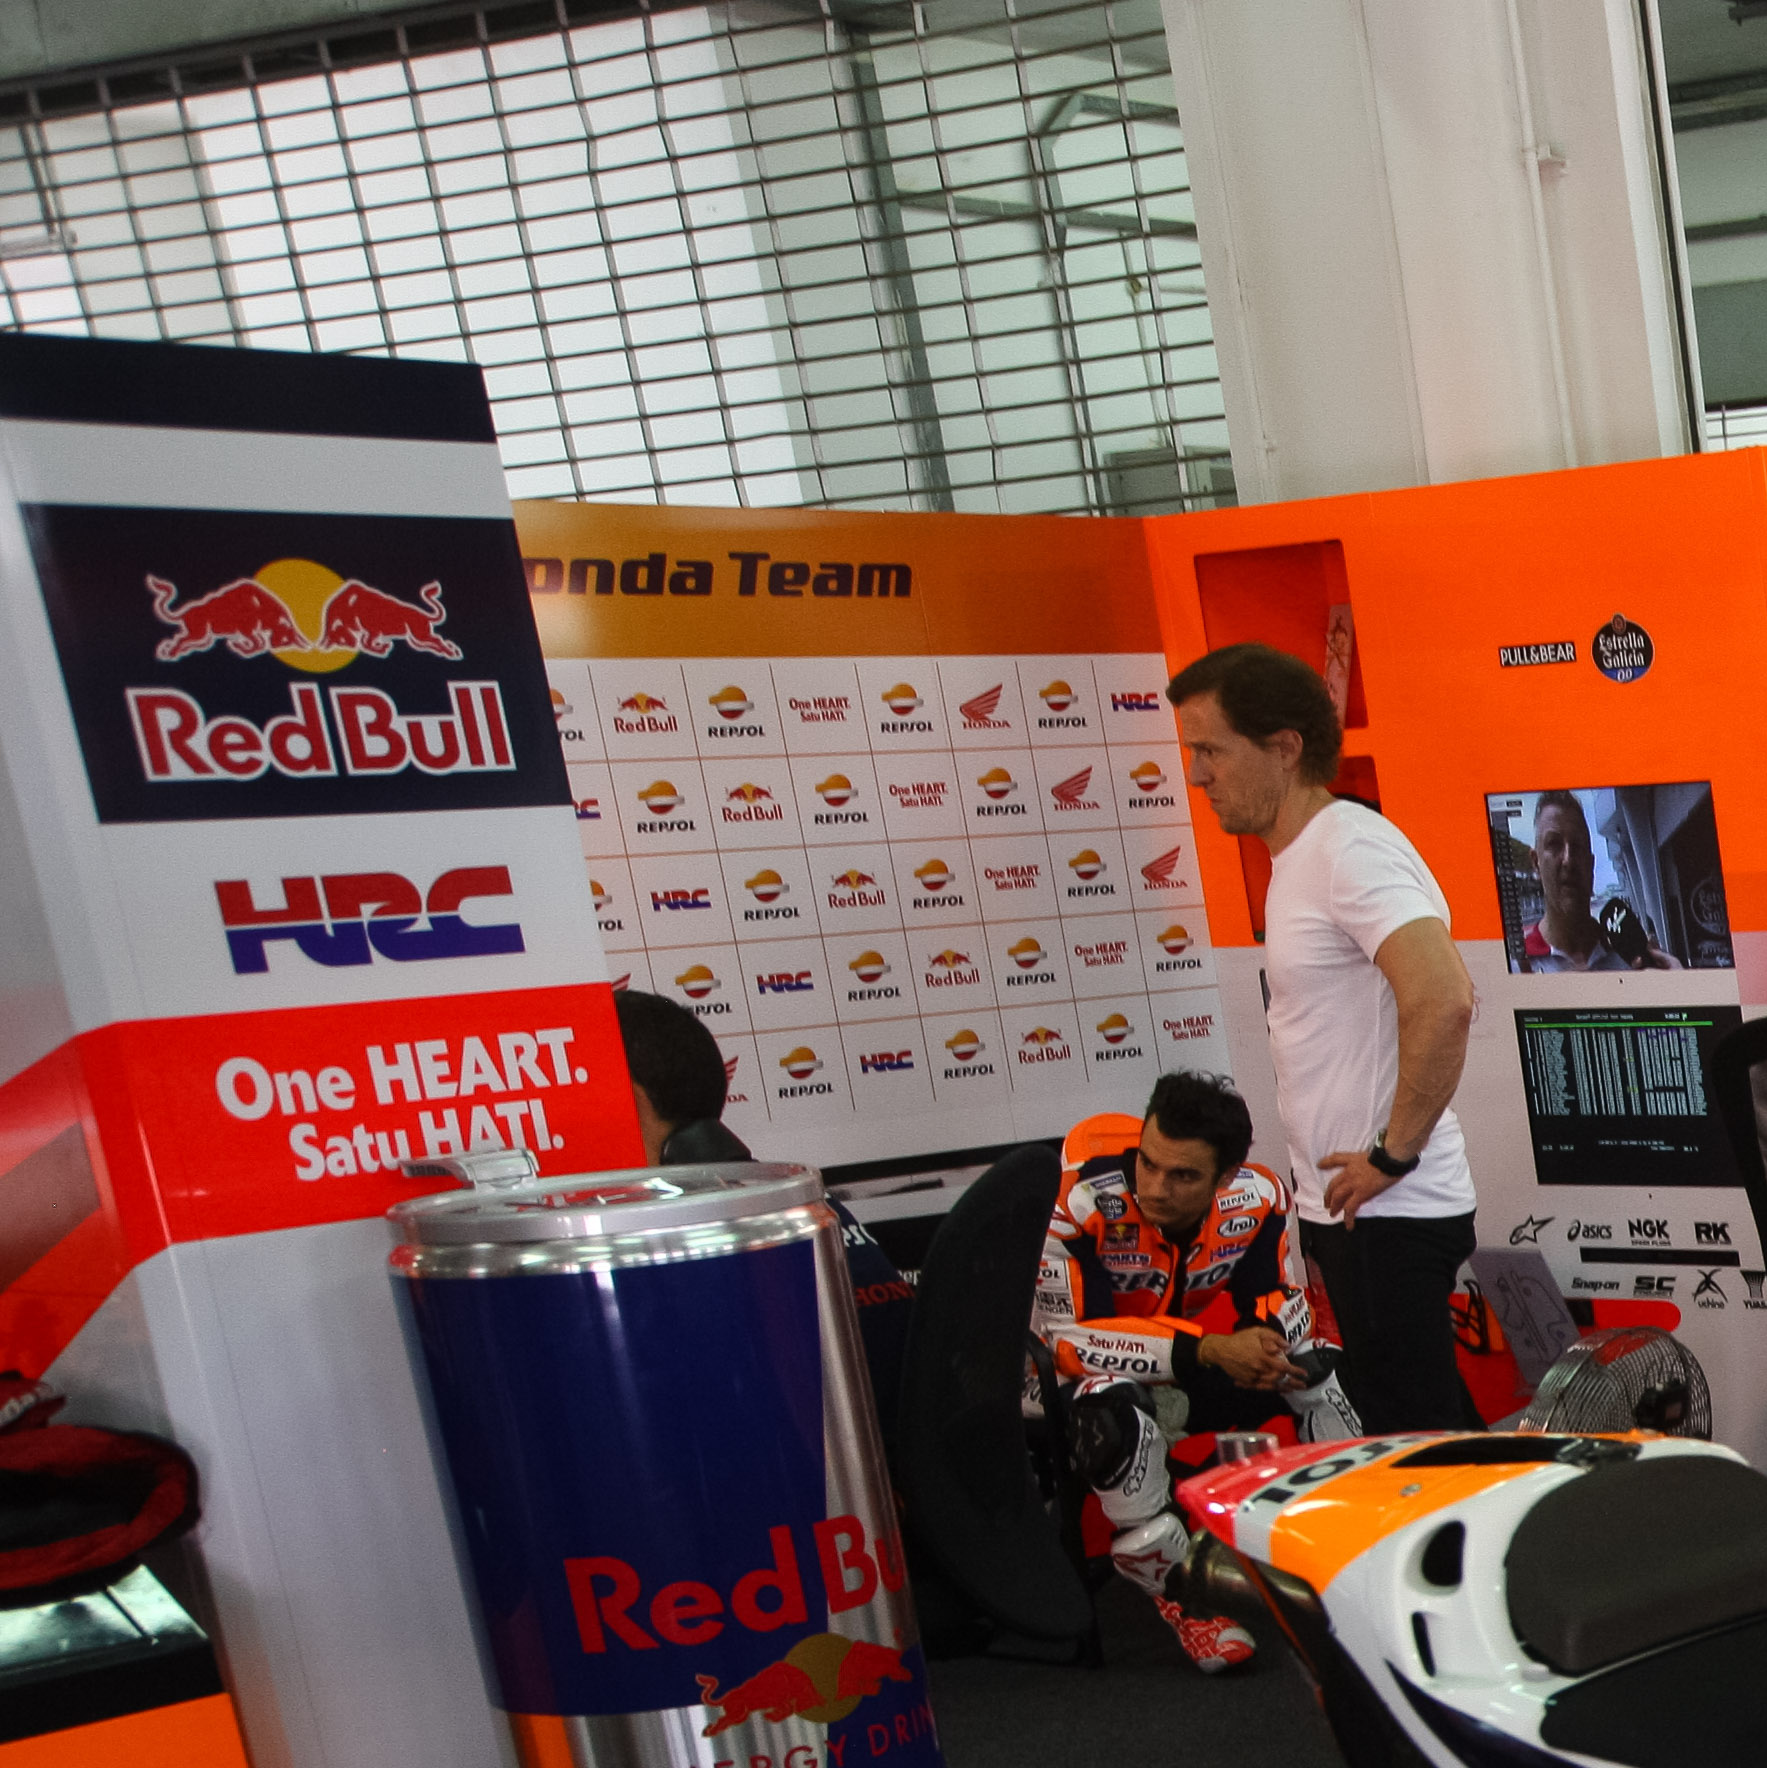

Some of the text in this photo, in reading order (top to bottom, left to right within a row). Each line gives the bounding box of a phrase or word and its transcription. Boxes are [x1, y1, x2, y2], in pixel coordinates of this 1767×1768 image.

[522, 551, 912, 598] onda Team
[1599, 632, 1645, 650] Estrella
[1500, 642, 1574, 666] PULL&BEAR
[1602, 650, 1645, 669] Galicia
[1111, 692, 1160, 712] HRC
[880, 721, 934, 733] REPSOL
[962, 719, 1012, 730] HONDA
[1037, 717, 1088, 729] REPSOL
[125, 680, 517, 783] Red Bull
[707, 725, 766, 738] REPSOL
[1053, 800, 1101, 811] HONDA
[1128, 796, 1176, 809] REPSOL
[976, 804, 1027, 817] REPSOL
[814, 812, 869, 825] REPSOL
[637, 820, 697, 833] REPSOL
[1067, 884, 1116, 897] REPSOL
[1143, 879, 1188, 891] HONDA
[651, 888, 712, 912] HRC
[912, 895, 965, 909] REPSOL
[213, 866, 526, 974] HRC
[744, 907, 800, 921] REPSOL
[1155, 958, 1203, 973] REPSOL
[756, 971, 814, 994] HRC
[1006, 972, 1057, 987] REPSOL
[847, 988, 901, 1002] REPSOL
[1095, 1047, 1143, 1062] REPSOL
[859, 1050, 914, 1075] HRC
[214, 1027, 590, 1123] One HEART.
[943, 1064, 995, 1080] REPSOL
[778, 1083, 834, 1099] REPSOL
[288, 1098, 566, 1182] Satu HATI.
[1582, 1223, 1613, 1240] asics
[1628, 1219, 1671, 1239] NGK
[1694, 1222, 1732, 1243] RK
[1571, 1277, 1620, 1291] Snap-on
[1634, 1276, 1676, 1291] SC
[563, 1524, 809, 1655] Red
